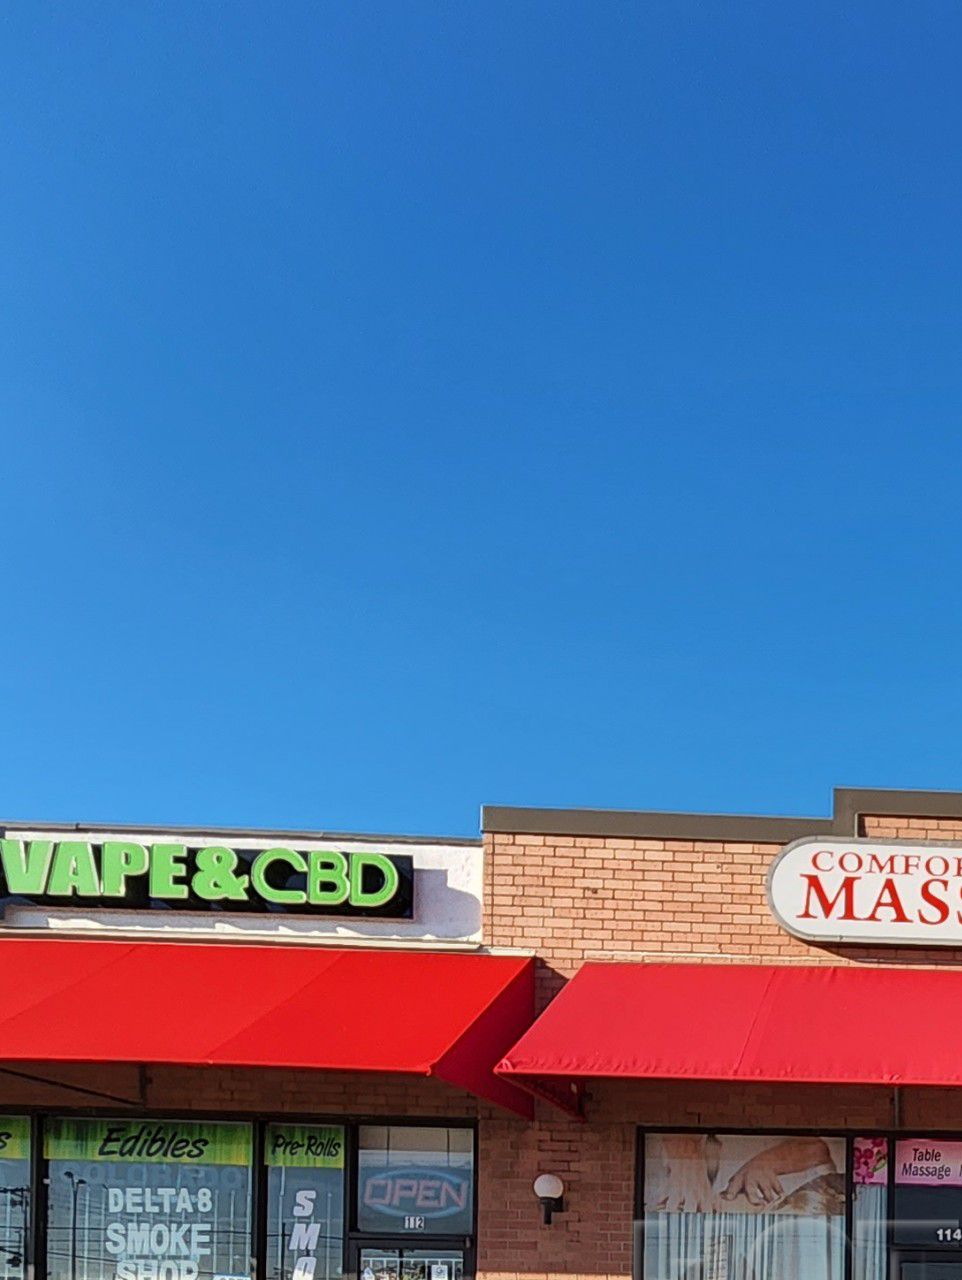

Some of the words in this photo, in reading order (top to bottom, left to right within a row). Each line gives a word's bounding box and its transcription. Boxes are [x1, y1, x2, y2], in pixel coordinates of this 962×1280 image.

[97, 1126, 209, 1158] Edibles
[272, 1135, 341, 1158] Pre-Rolls
[912, 1148, 941, 1162] Table
[901, 1163, 951, 1179] Massage
[364, 1179, 469, 1210] OPEN
[404, 1216, 424, 1229] 112
[106, 1223, 211, 1255] SMOKE
[937, 1228, 962, 1241] 114
